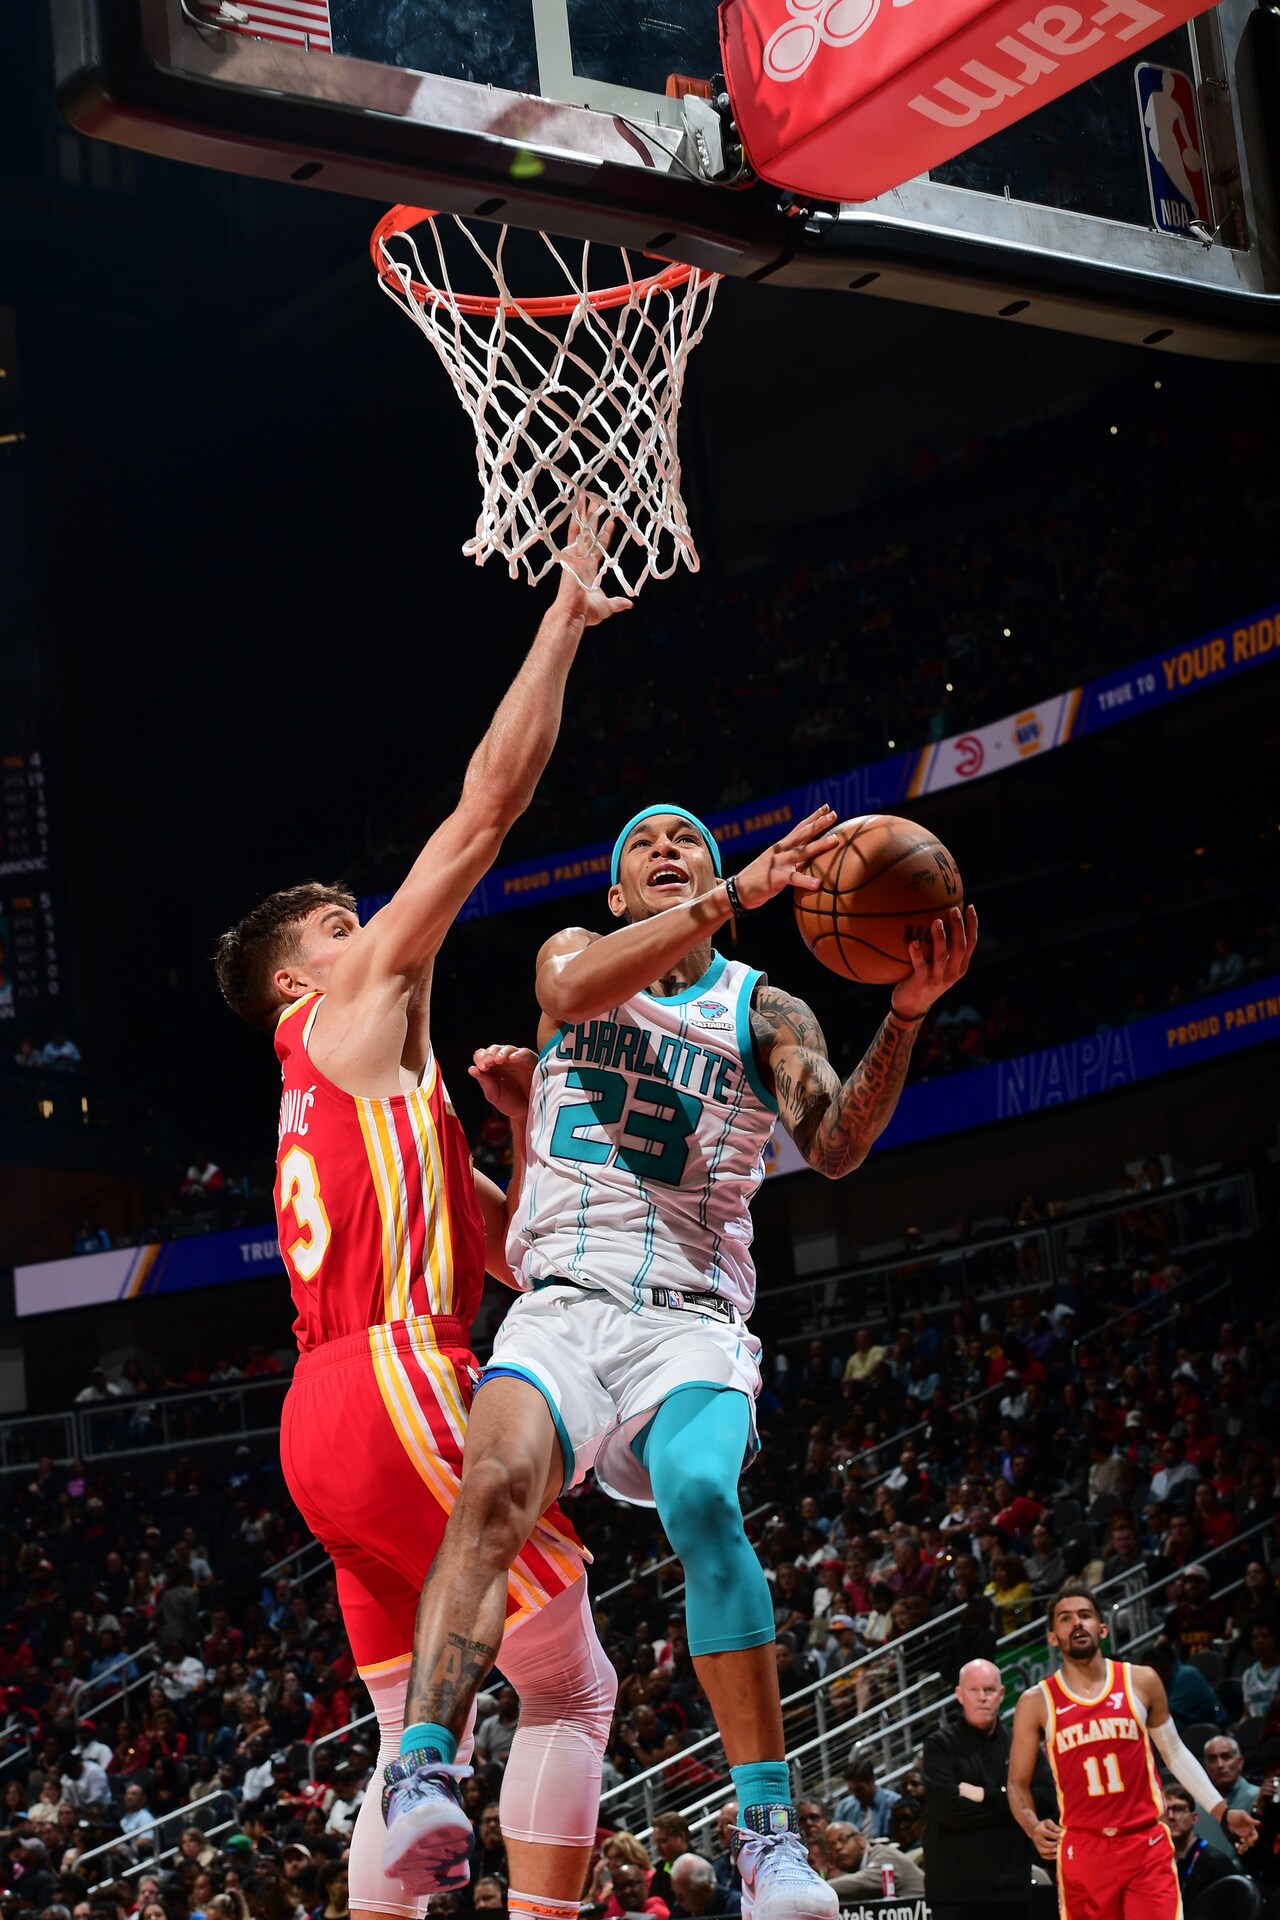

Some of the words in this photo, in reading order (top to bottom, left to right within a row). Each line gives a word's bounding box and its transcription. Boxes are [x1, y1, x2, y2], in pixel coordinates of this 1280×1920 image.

[1161, 199, 1190, 229] NBA
[1097, 681, 1135, 712] TRUE
[1135, 671, 1156, 696] TO
[1161, 637, 1227, 692] YOUR
[503, 869, 550, 896] PROUD
[553, 854, 611, 883] PARTNE
[1166, 1015, 1221, 1049] PROUD
[1224, 995, 1280, 1031] PARTN
[556, 1019, 736, 1104] CHARLOTTE
[996, 1023, 1139, 1120] NAPA
[549, 1066, 704, 1187] 23
[1055, 1717, 1140, 1755] ATLANTA
[1083, 1752, 1125, 1797] 11
